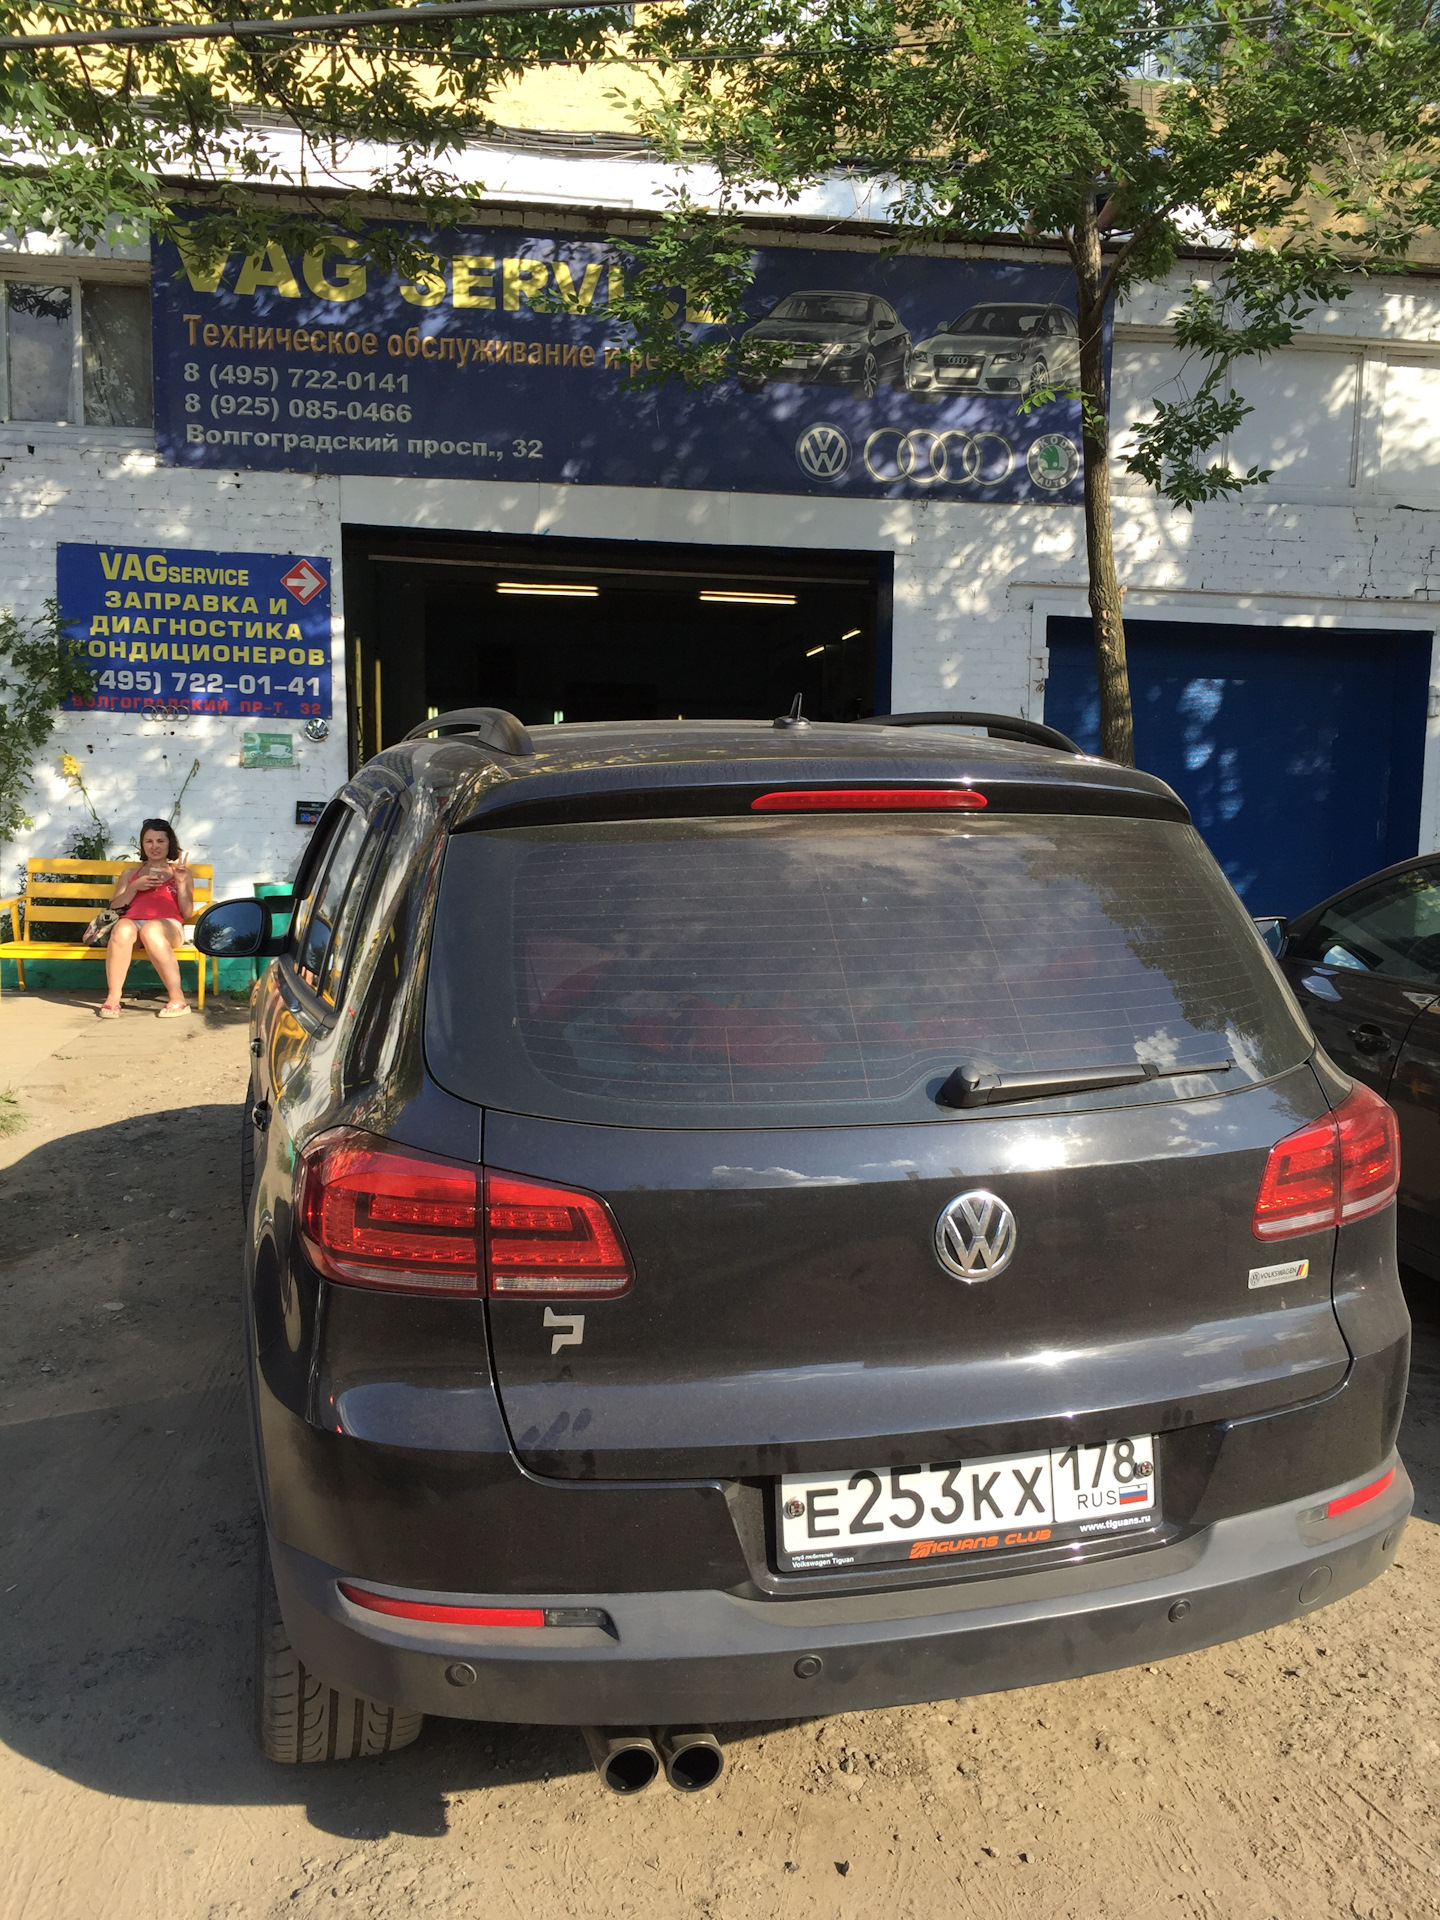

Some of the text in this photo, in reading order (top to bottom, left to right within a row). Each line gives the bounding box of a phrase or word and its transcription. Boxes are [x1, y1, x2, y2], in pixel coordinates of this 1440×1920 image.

[171, 225, 728, 324] VAG SERVIE
[182, 314, 378, 356] Техническое
[387, 326, 596, 369] обслуживание
[183, 363, 409, 394] 8 (495) 722-0141
[184, 394, 412, 423] 8 (925) 085-0466
[185, 424, 543, 460] Волгоградский просп., 32
[1038, 477, 1067, 487] AUTO
[105, 590, 288, 615] ЗАПРАВКА И
[89, 615, 303, 640] ДИАГНОСТИКА
[171, 672, 320, 697] 722-01-41
[300, 702, 322, 715] 32
[1260, 1267, 1297, 1280] VOLKSWAGEN
[1058, 1438, 1136, 1491] 178
[1077, 1489, 1117, 1510] RUS
[1080, 1515, 1151, 1533] www.tiguans.ru
[1005, 1529, 1052, 1546] CLUB
[791, 1557, 854, 1568] Volkswagen Tiguan
